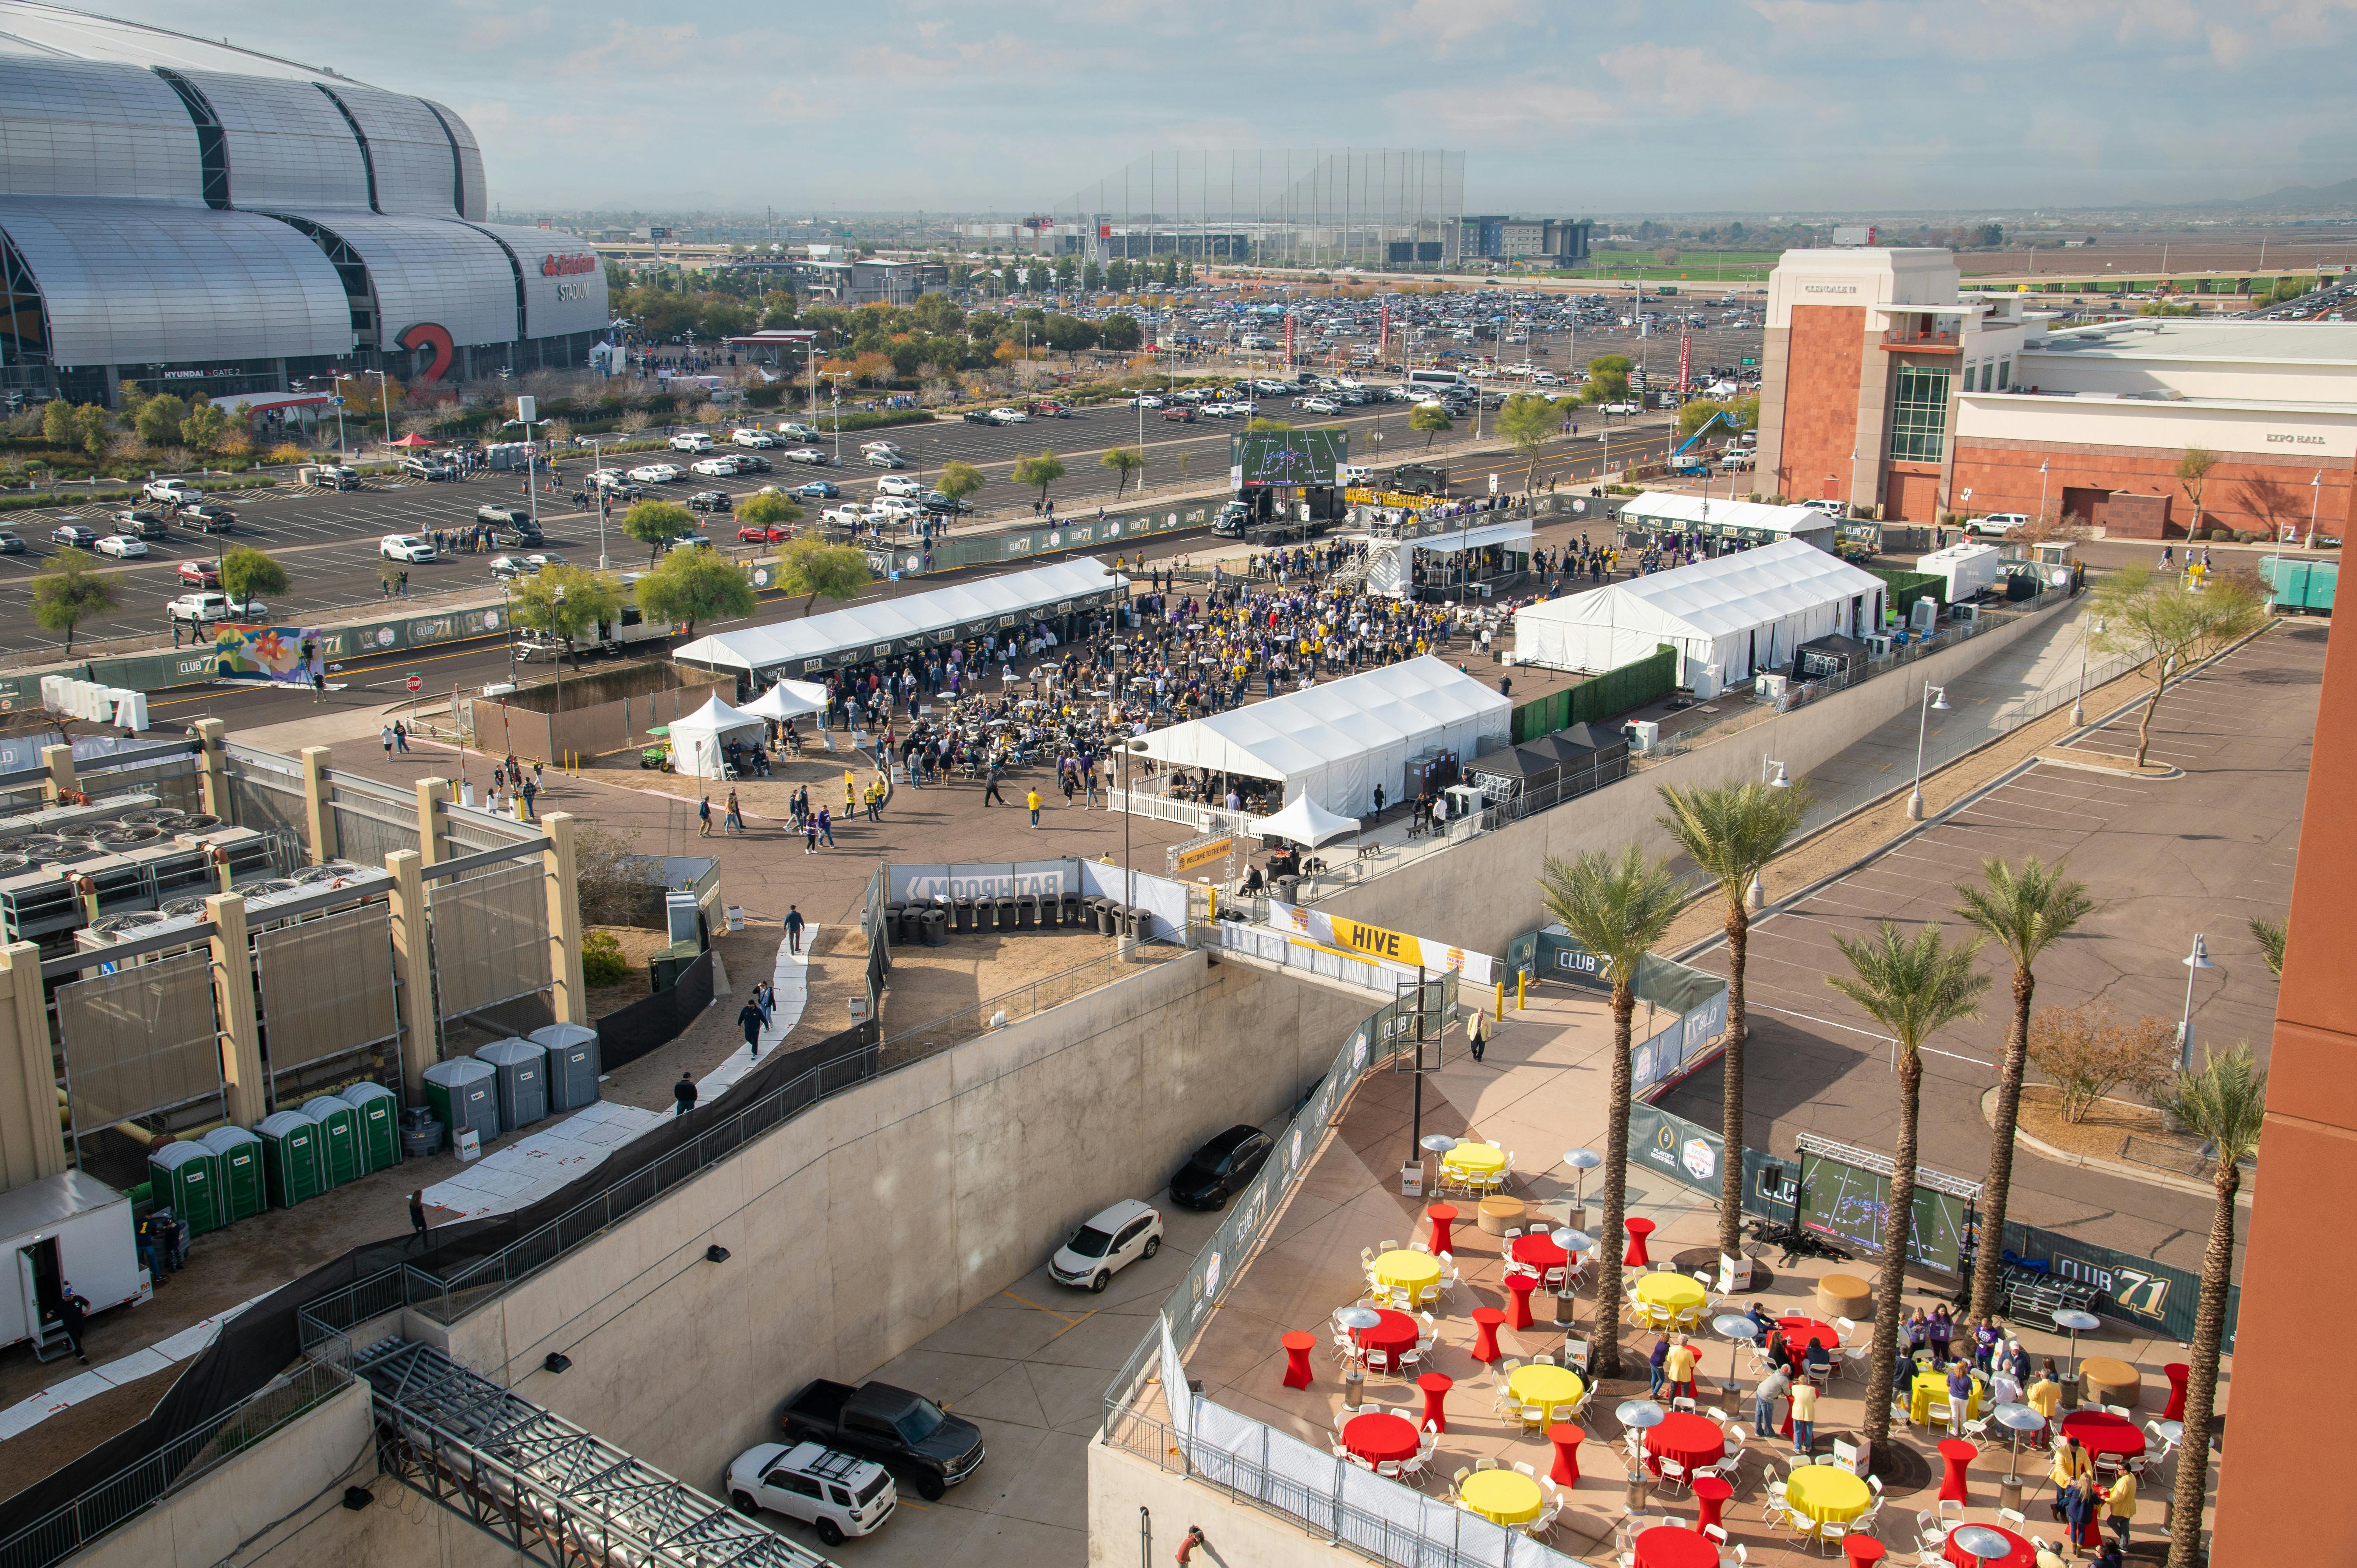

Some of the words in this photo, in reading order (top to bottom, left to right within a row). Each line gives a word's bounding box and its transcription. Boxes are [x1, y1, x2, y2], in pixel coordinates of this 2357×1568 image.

[559, 283, 590, 301] STADIUM
[1805, 285, 1848, 293] GLENDALE
[2267, 434, 2294, 443] EXPO
[2297, 435, 2326, 444] HALL
[1846, 526, 1861, 535] CLUB
[1059, 602, 1069, 611] BAR
[1002, 616, 1013, 626] BAR
[417, 625, 435, 636] CLUB
[941, 630, 953, 640] BAR
[876, 645, 889, 655] BAR
[180, 660, 202, 673] CLUB
[806, 660, 819, 670] BAR
[40, 675, 113, 723] CLUB
[1187, 853, 1205, 864] WELCOME
[1220, 844, 1229, 853] HIVE
[1352, 925, 1400, 957] HIVE
[1560, 952, 1595, 971] CLUB
[463, 1141, 479, 1151] WM
[1650, 1152, 1675, 1167] SEMIFINAL
[1653, 1147, 1675, 1161] PLAYOFF
[1238, 1208, 1253, 1243] CLUB
[1721, 1265, 1732, 1277] WM
[2061, 1260, 2111, 1291] CLUB
[1567, 1352, 1586, 1361] WM
[1836, 1453, 1854, 1467] WM
[1857, 1455, 1869, 1466] WM
